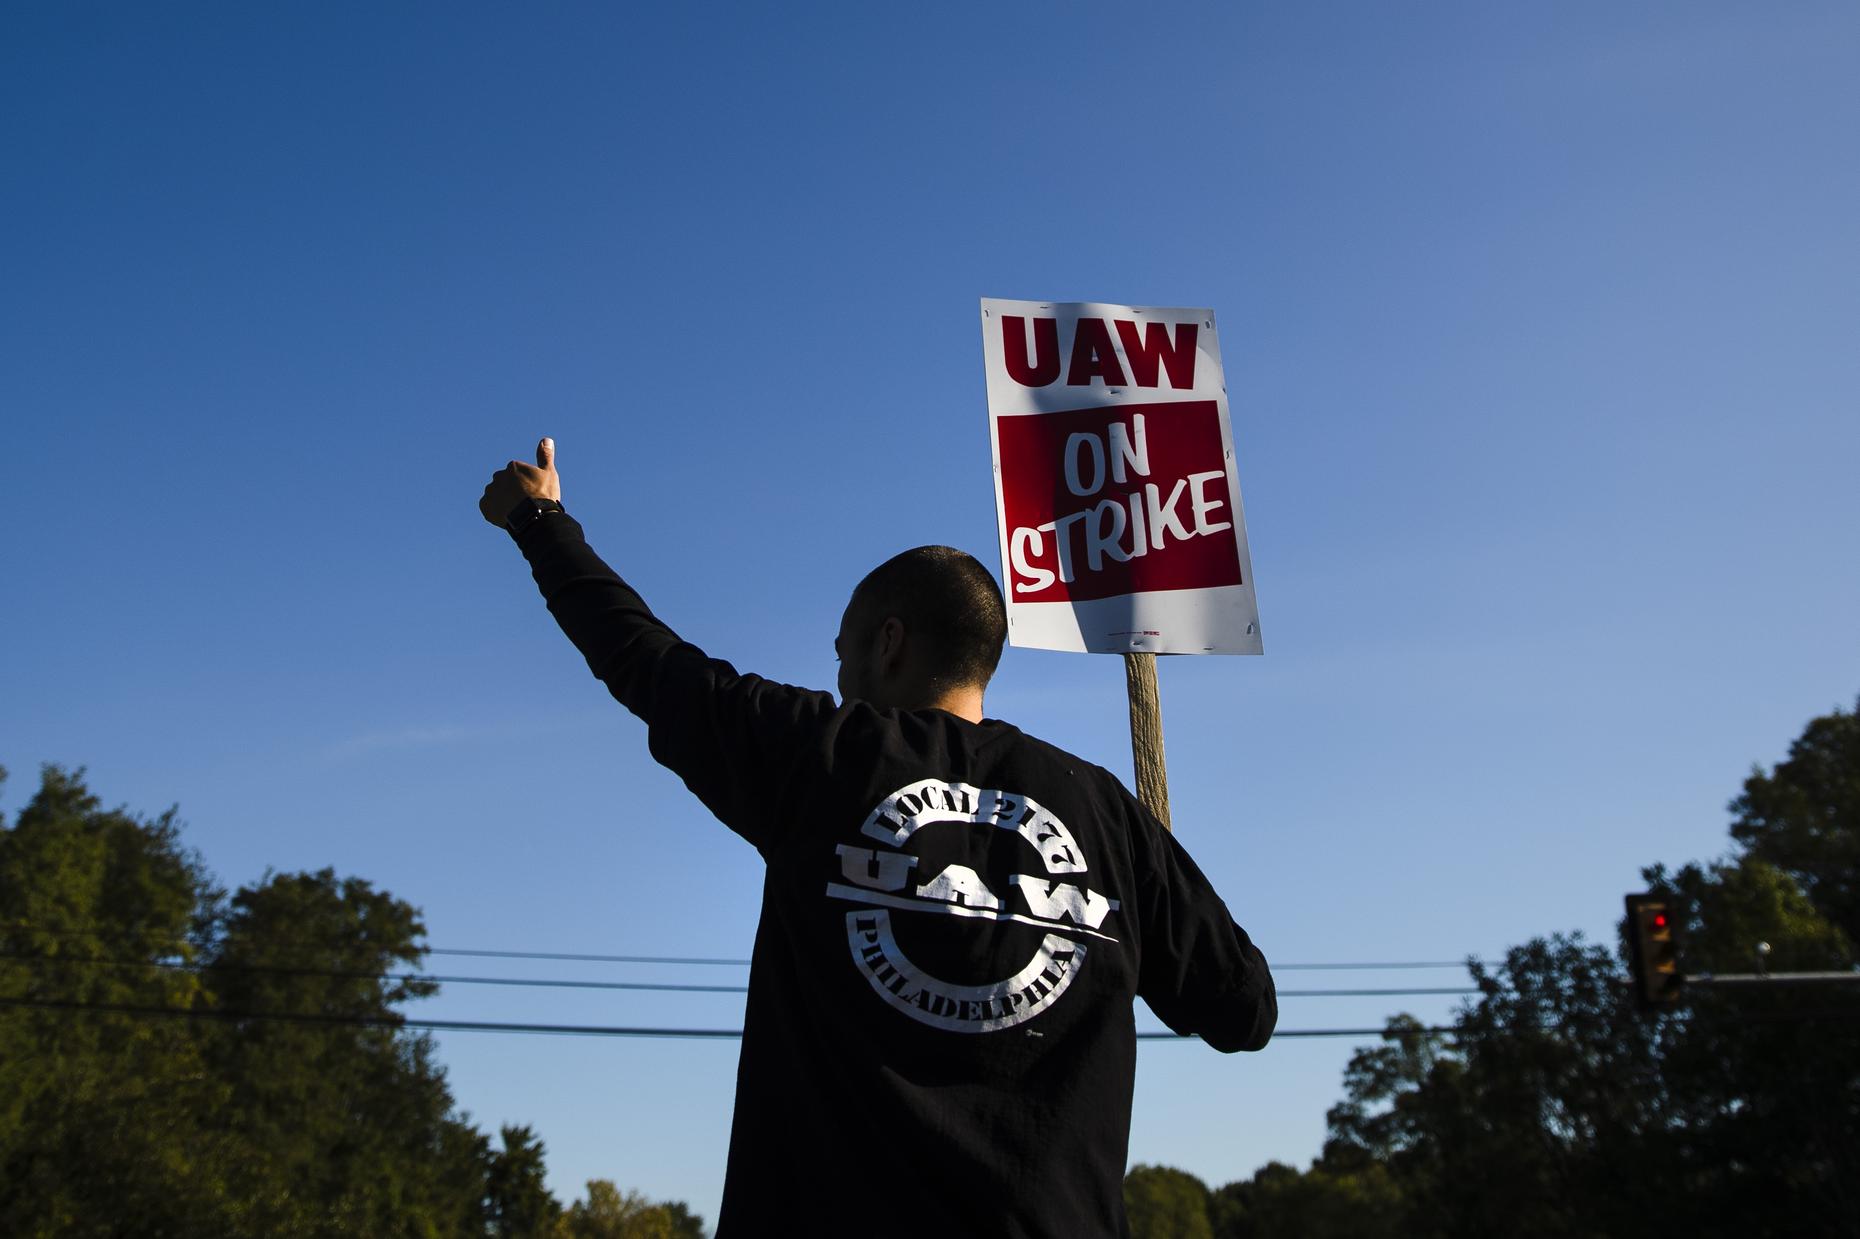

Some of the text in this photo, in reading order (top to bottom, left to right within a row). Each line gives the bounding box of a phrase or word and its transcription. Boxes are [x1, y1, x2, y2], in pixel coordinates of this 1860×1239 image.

[1001, 315, 1199, 390] UAW
[1064, 413, 1151, 497] ON
[1010, 470, 1232, 593] STRIKE
[873, 785, 1077, 866] LOCAL 2177
[835, 843, 1120, 930] UAW
[855, 916, 1076, 1022] PHILADELPHIA
